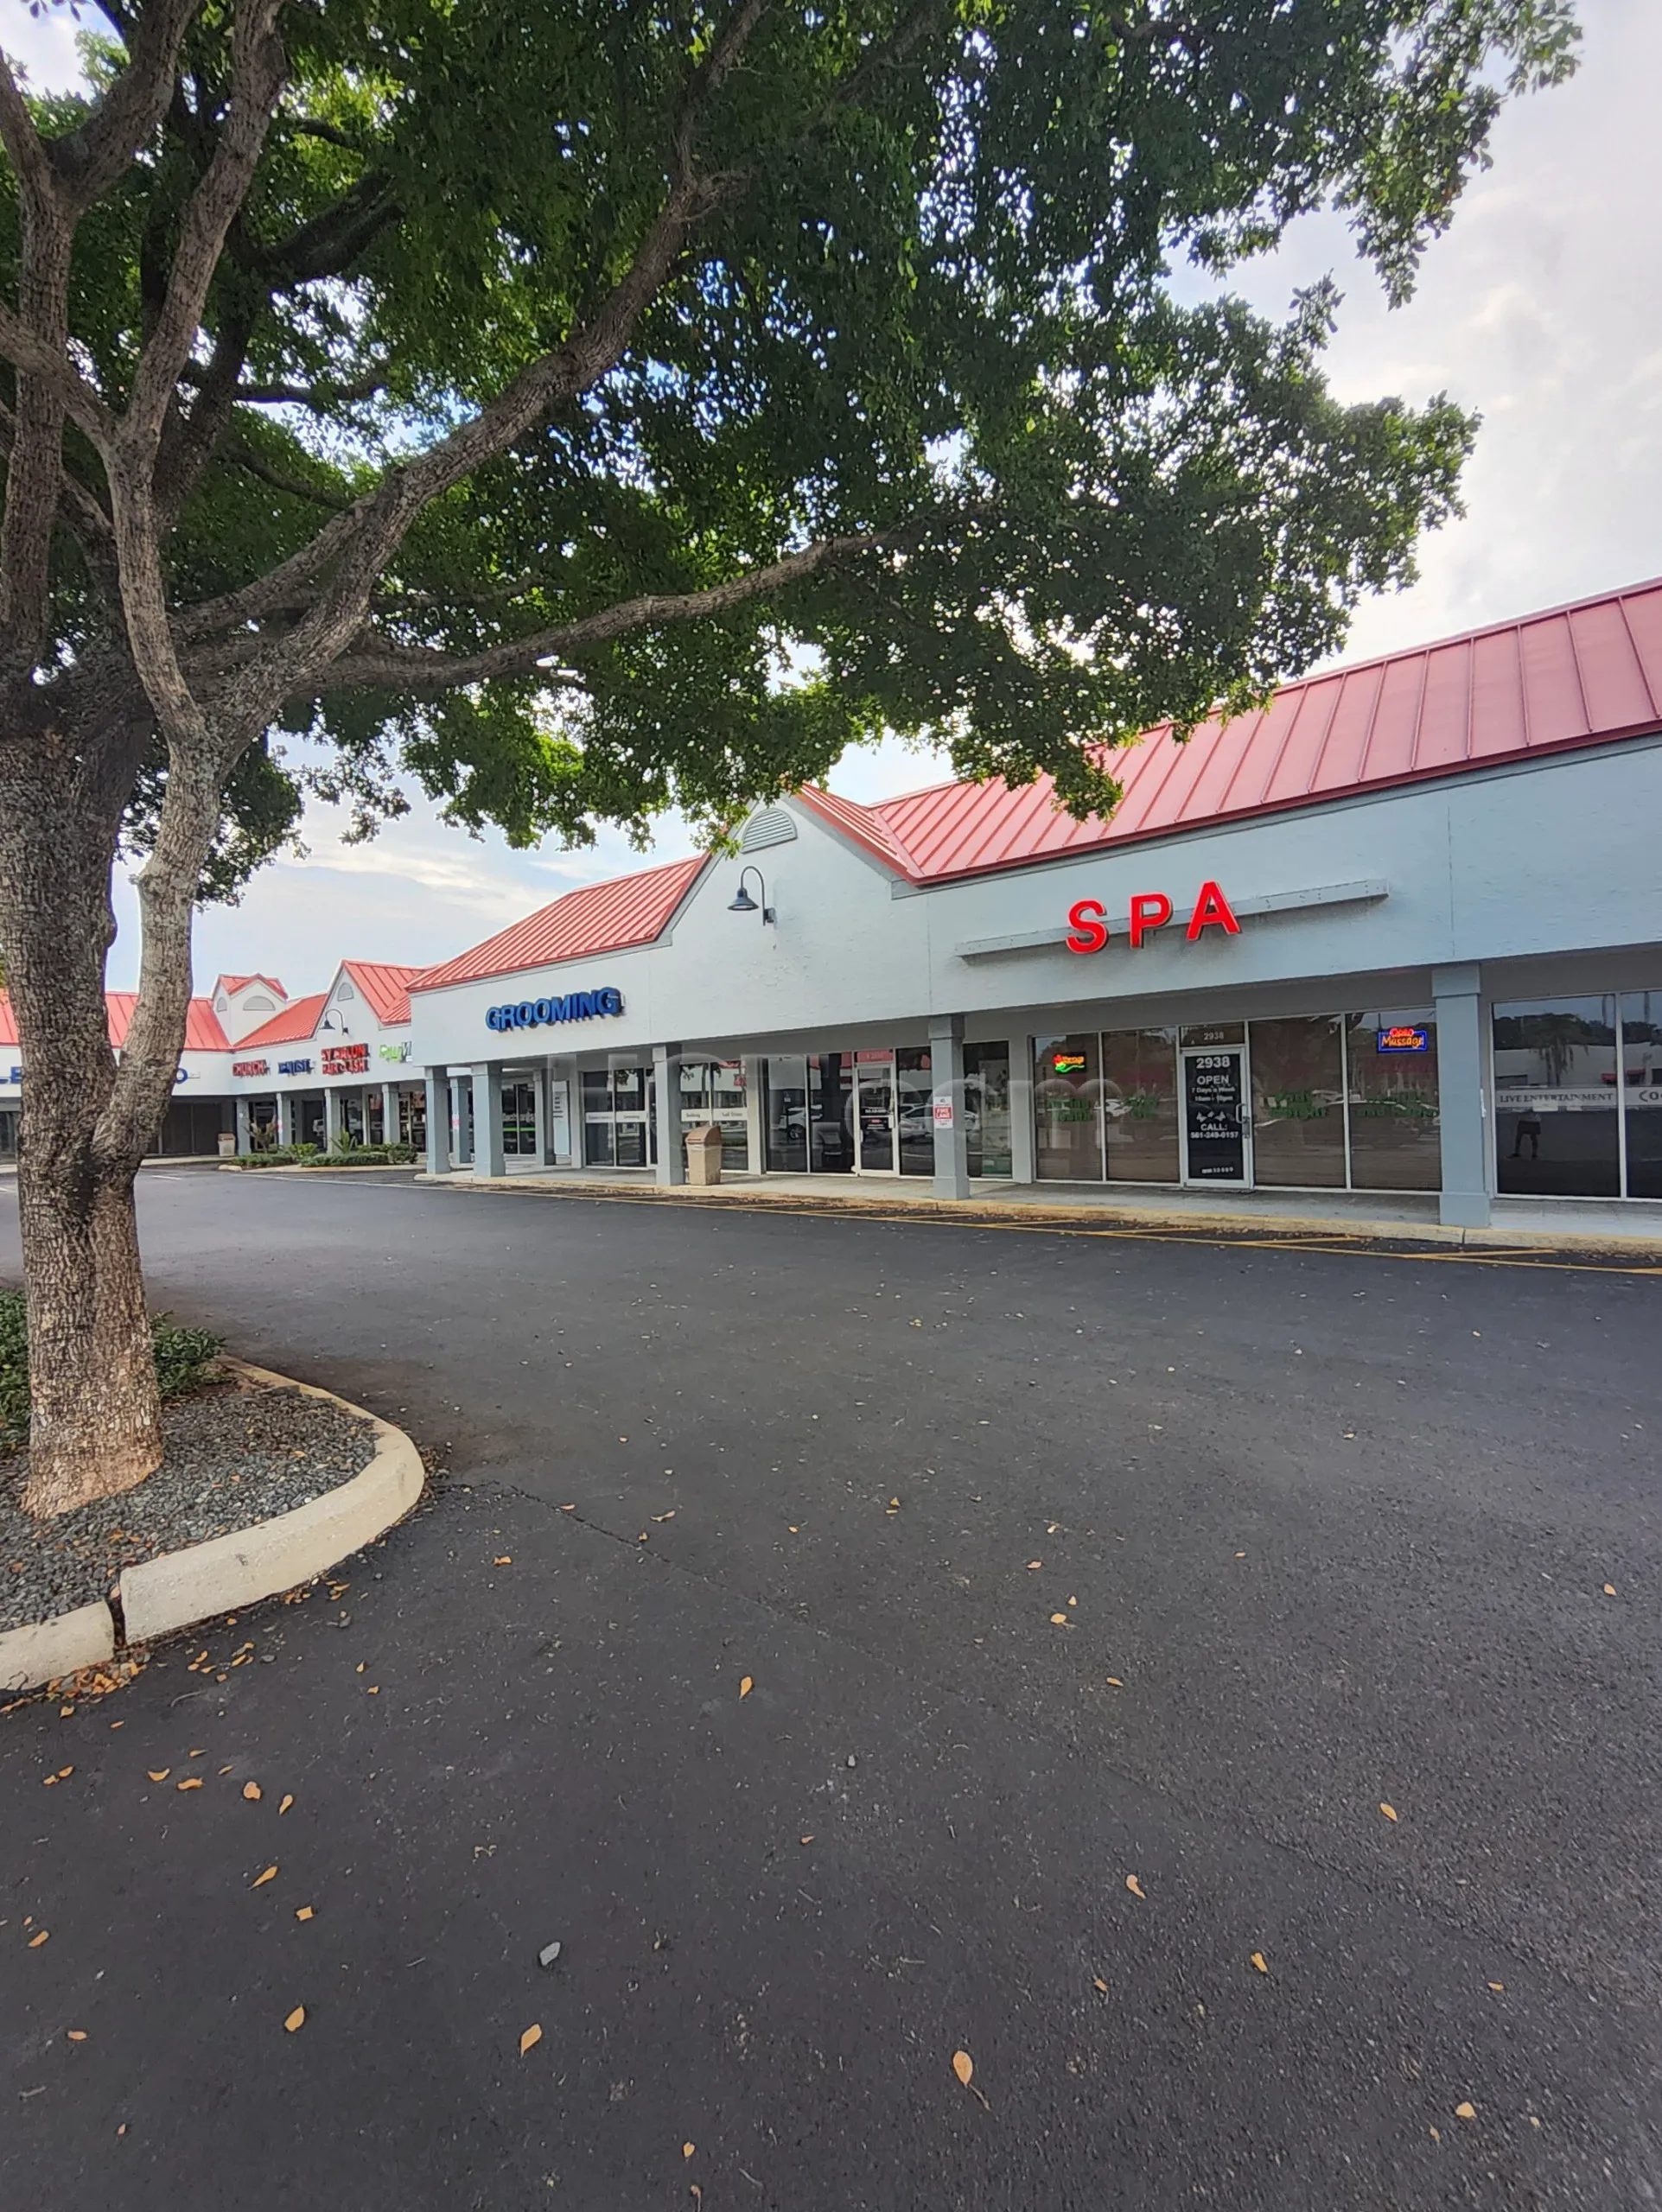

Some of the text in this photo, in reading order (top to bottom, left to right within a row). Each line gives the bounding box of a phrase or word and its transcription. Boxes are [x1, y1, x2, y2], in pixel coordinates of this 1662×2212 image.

[1066, 880, 1241, 954] SPA
[486, 987, 621, 1031] GROOMING
[1204, 1032, 1224, 1040] 2938
[1381, 1036, 1424, 1049] Massage
[1196, 1056, 1231, 1069] 2938
[1196, 1075, 1229, 1085] OPEN
